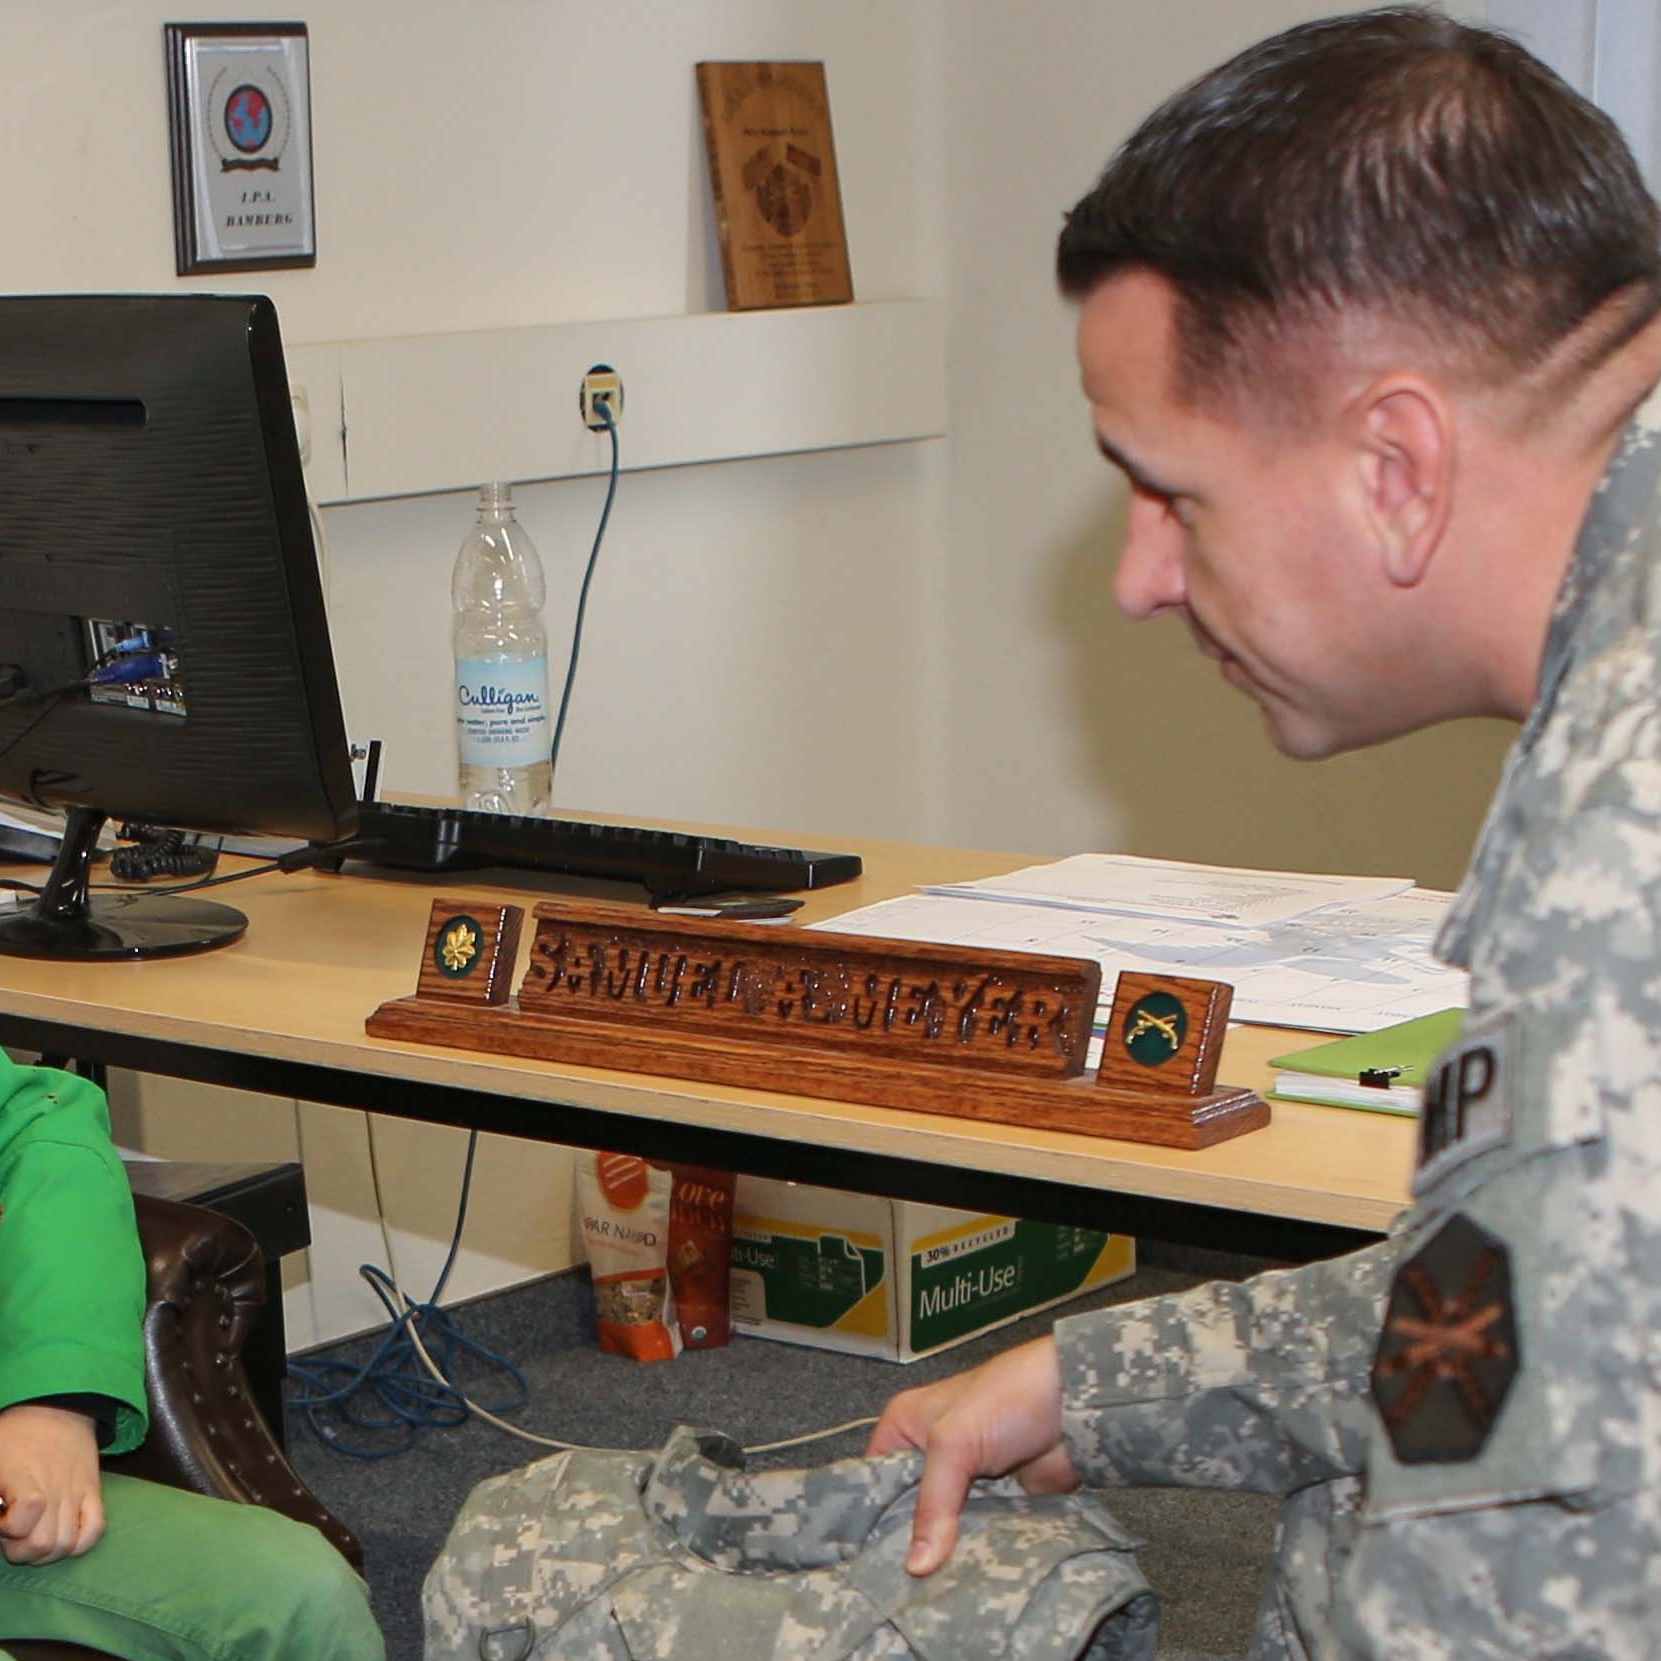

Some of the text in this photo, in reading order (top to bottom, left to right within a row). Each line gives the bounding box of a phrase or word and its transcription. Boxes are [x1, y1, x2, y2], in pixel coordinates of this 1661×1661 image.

[227, 213, 293, 227] BAMBERG
[459, 684, 539, 714] Culligan
[680, 1183, 725, 1209] ove
[927, 1245, 950, 1263] 30%
[919, 1264, 1015, 1320] Multi-Use
